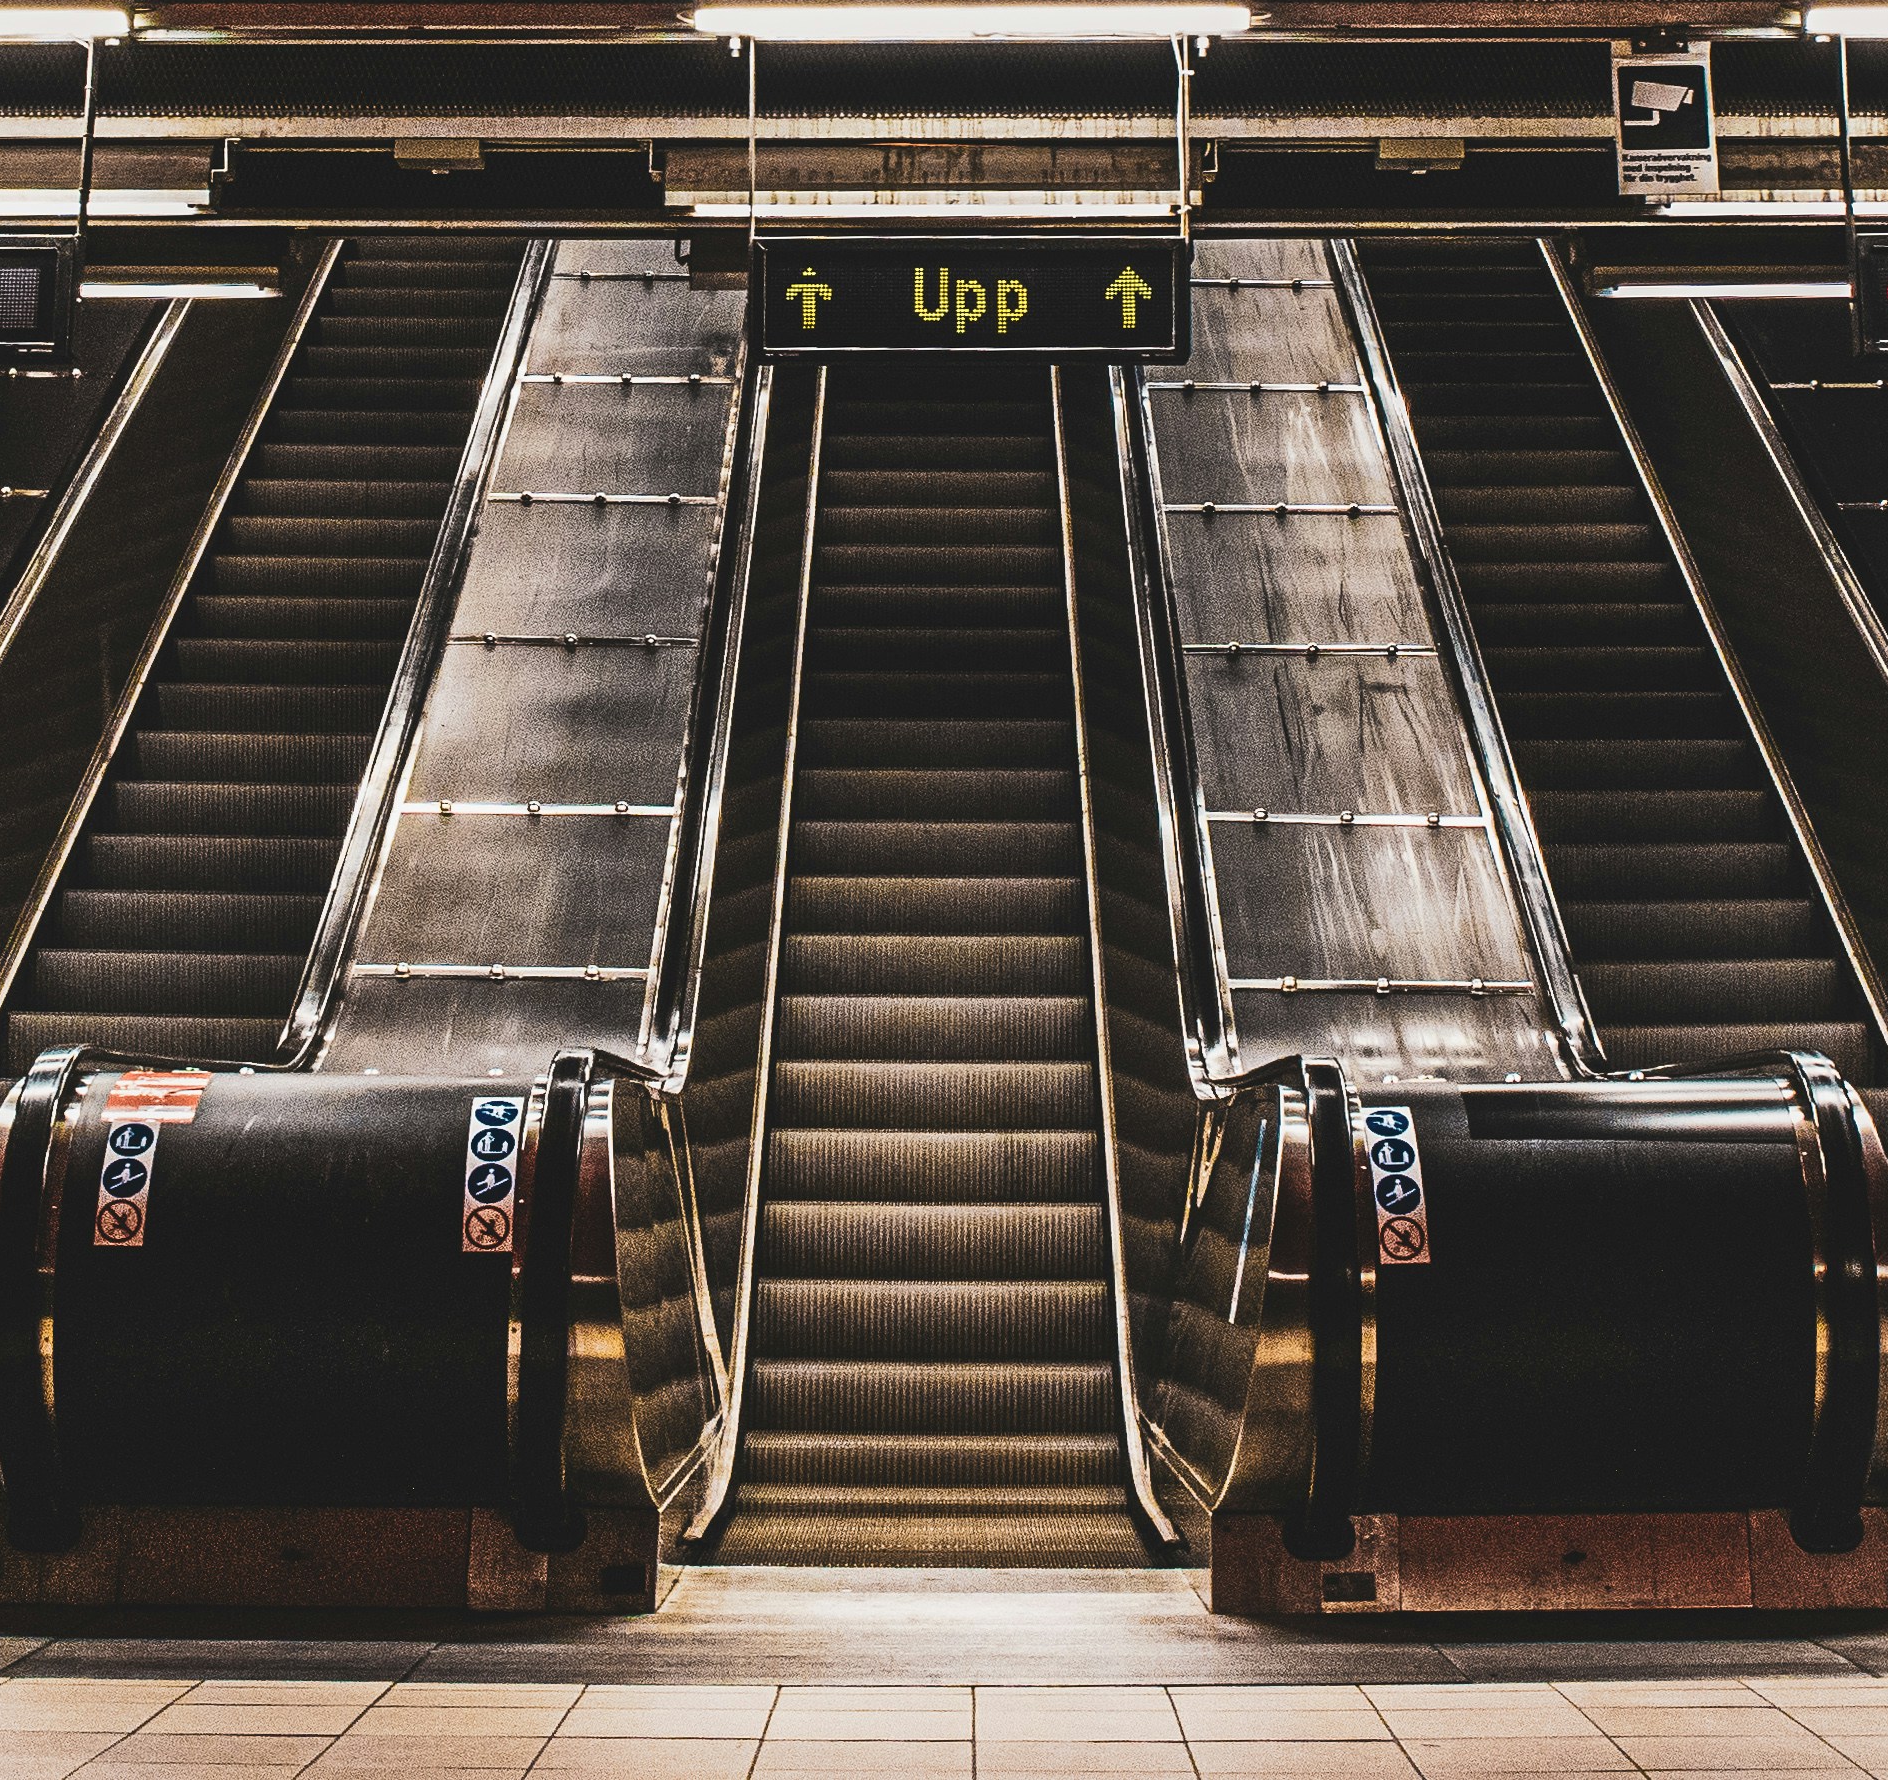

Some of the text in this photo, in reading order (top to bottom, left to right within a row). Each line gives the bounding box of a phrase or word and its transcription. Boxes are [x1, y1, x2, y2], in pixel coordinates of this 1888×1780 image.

[1622, 164, 1643, 172] med
[1645, 164, 1691, 173] inspelning
[1623, 173, 1637, 182] för
[1639, 173, 1654, 182] din
[912, 266, 1029, 334] Upp
